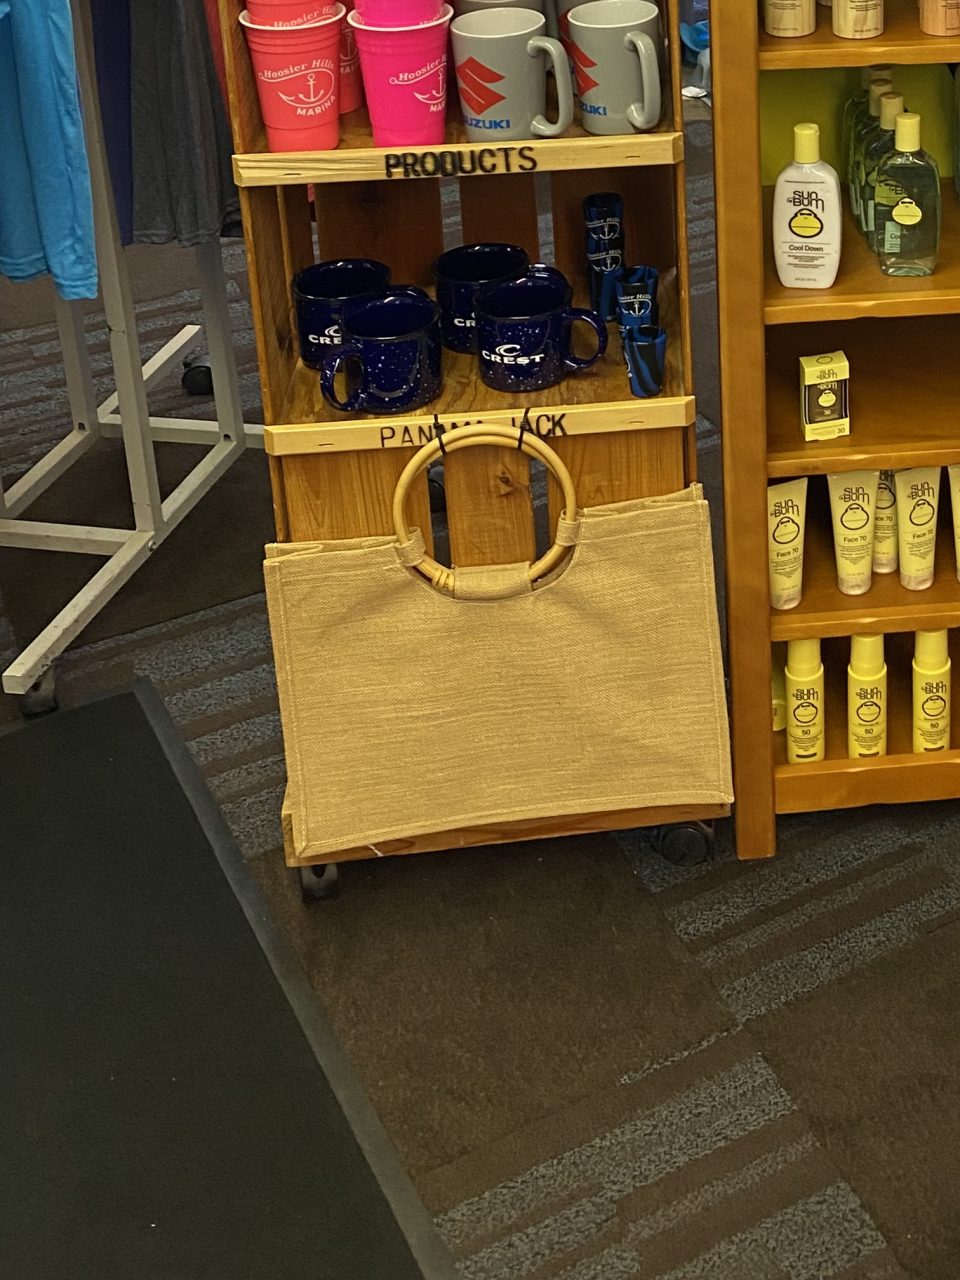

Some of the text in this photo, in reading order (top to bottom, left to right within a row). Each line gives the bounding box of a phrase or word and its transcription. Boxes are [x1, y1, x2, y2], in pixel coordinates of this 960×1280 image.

[263, 63, 308, 79] Hoosier
[312, 59, 334, 70] Hills
[399, 57, 440, 82] Hoosier
[296, 94, 336, 116] MARINA
[580, 100, 607, 116] ZUKI
[384, 146, 538, 178] PRODUCTS
[788, 244, 824, 253] Cool Down
[308, 334, 342, 345] CRE
[482, 350, 545, 365] CREST
[912, 532, 926, 540] Face
